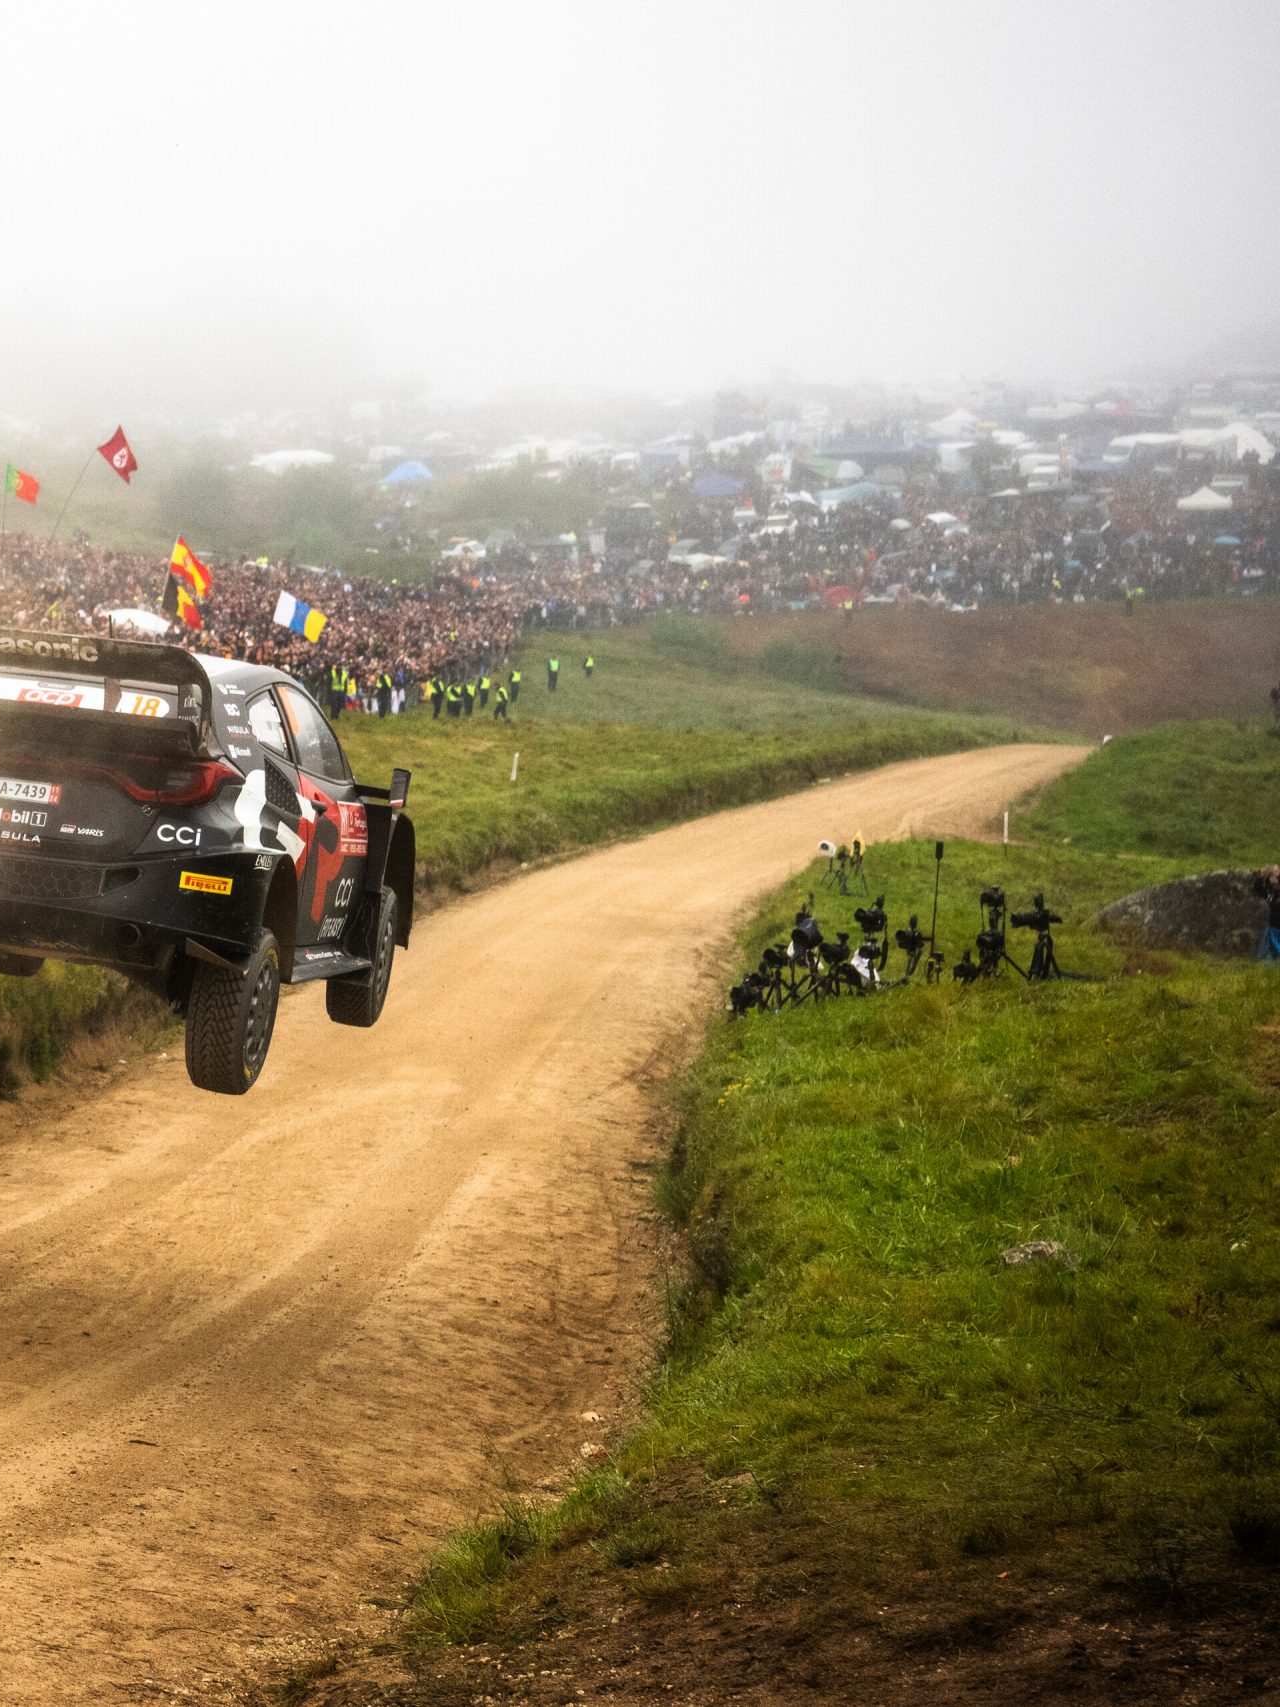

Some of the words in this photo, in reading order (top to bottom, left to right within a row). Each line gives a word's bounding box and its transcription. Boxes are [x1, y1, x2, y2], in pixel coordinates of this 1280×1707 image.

[24, 690, 76, 706] acp
[131, 693, 161, 717] 18
[0, 781, 47, 799] A-7439
[77, 827, 105, 837] YARIS
[184, 875, 229, 892] PIRELLI
